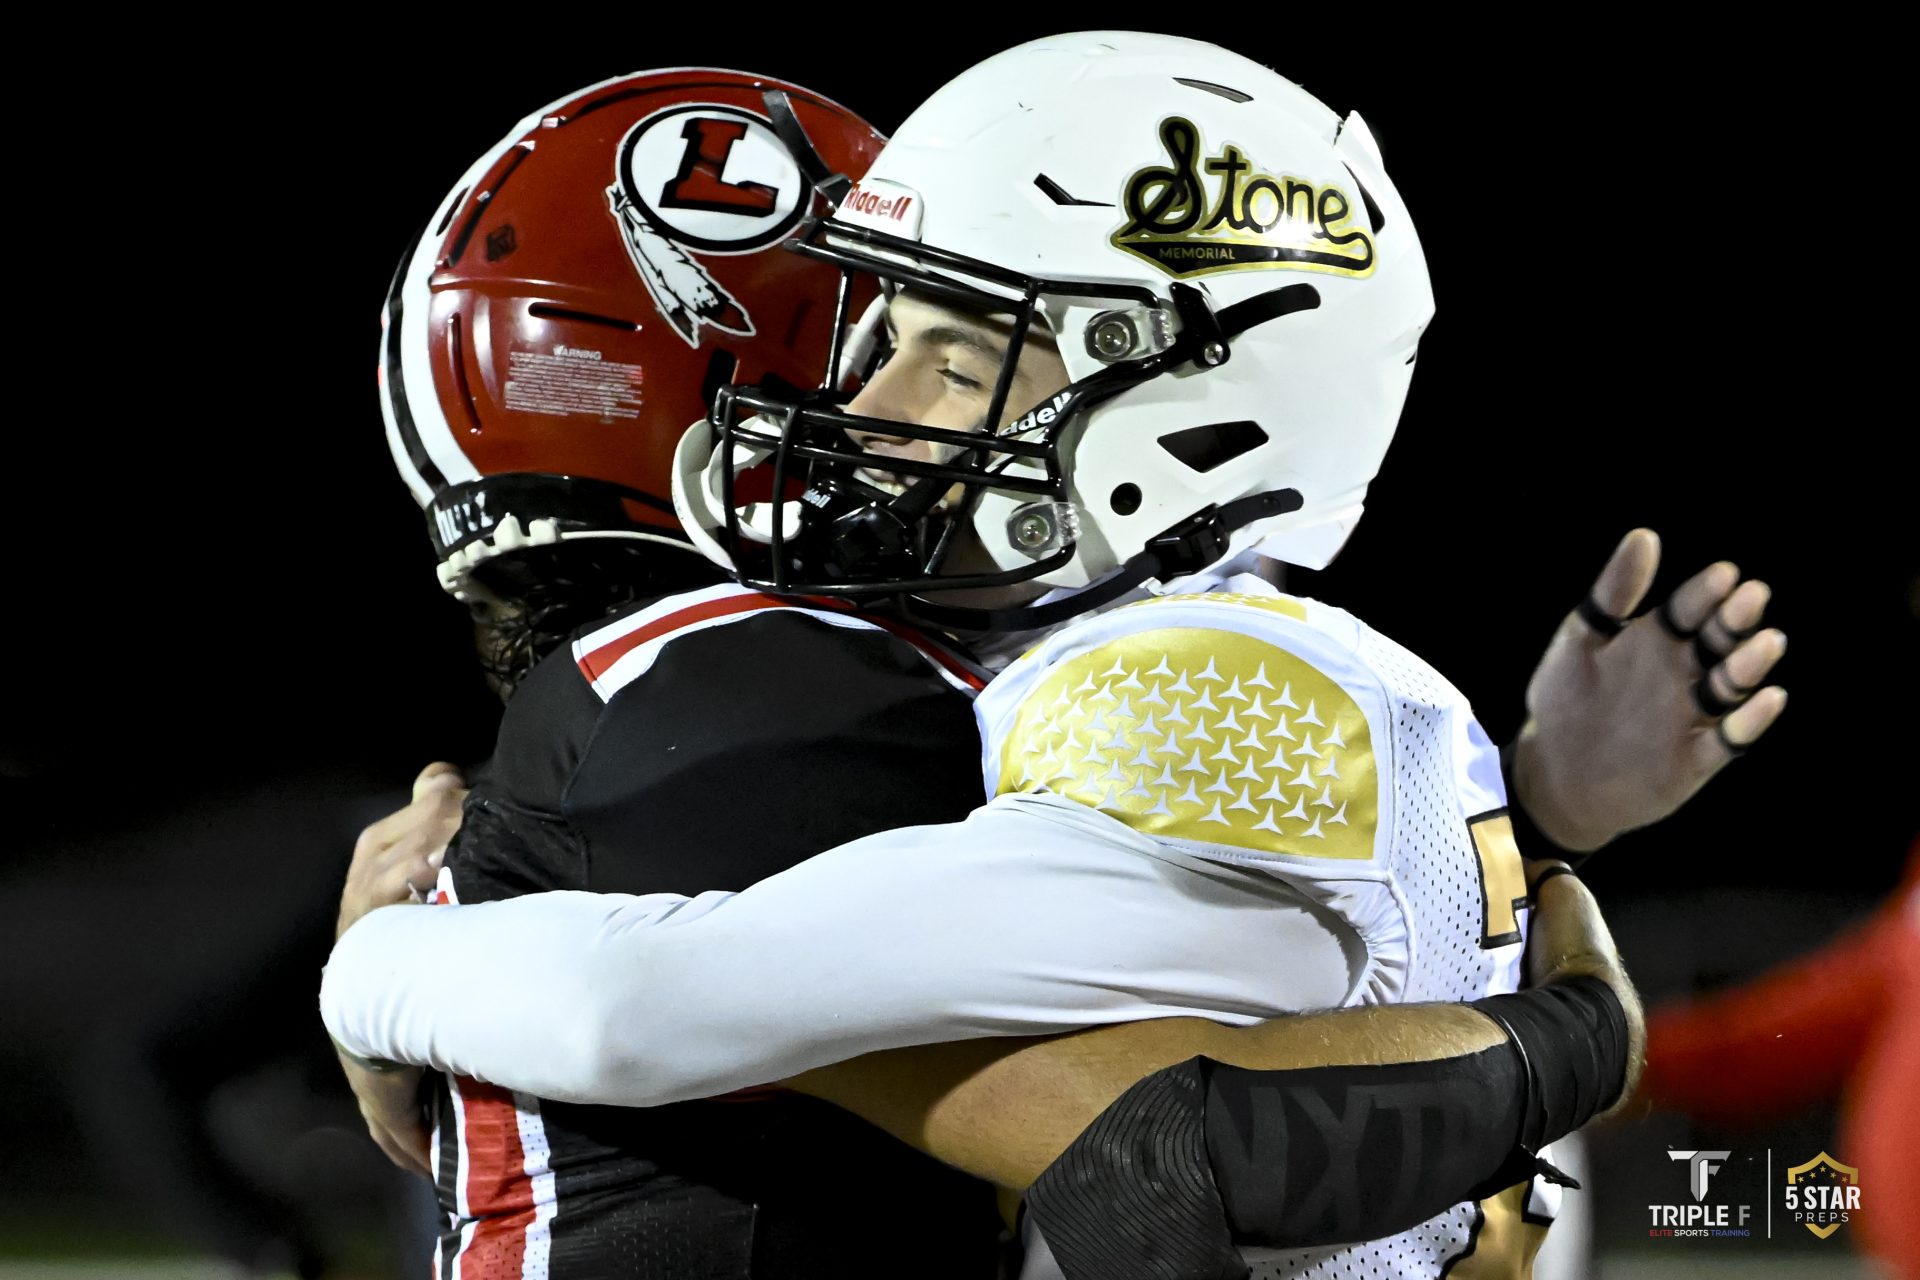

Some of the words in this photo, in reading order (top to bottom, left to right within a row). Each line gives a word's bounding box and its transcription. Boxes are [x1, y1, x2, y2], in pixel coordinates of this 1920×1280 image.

[658, 116, 780, 219] L
[1118, 115, 1373, 269] Stone
[1158, 247, 1236, 260] MEMORIAL
[553, 344, 602, 361] WARNING
